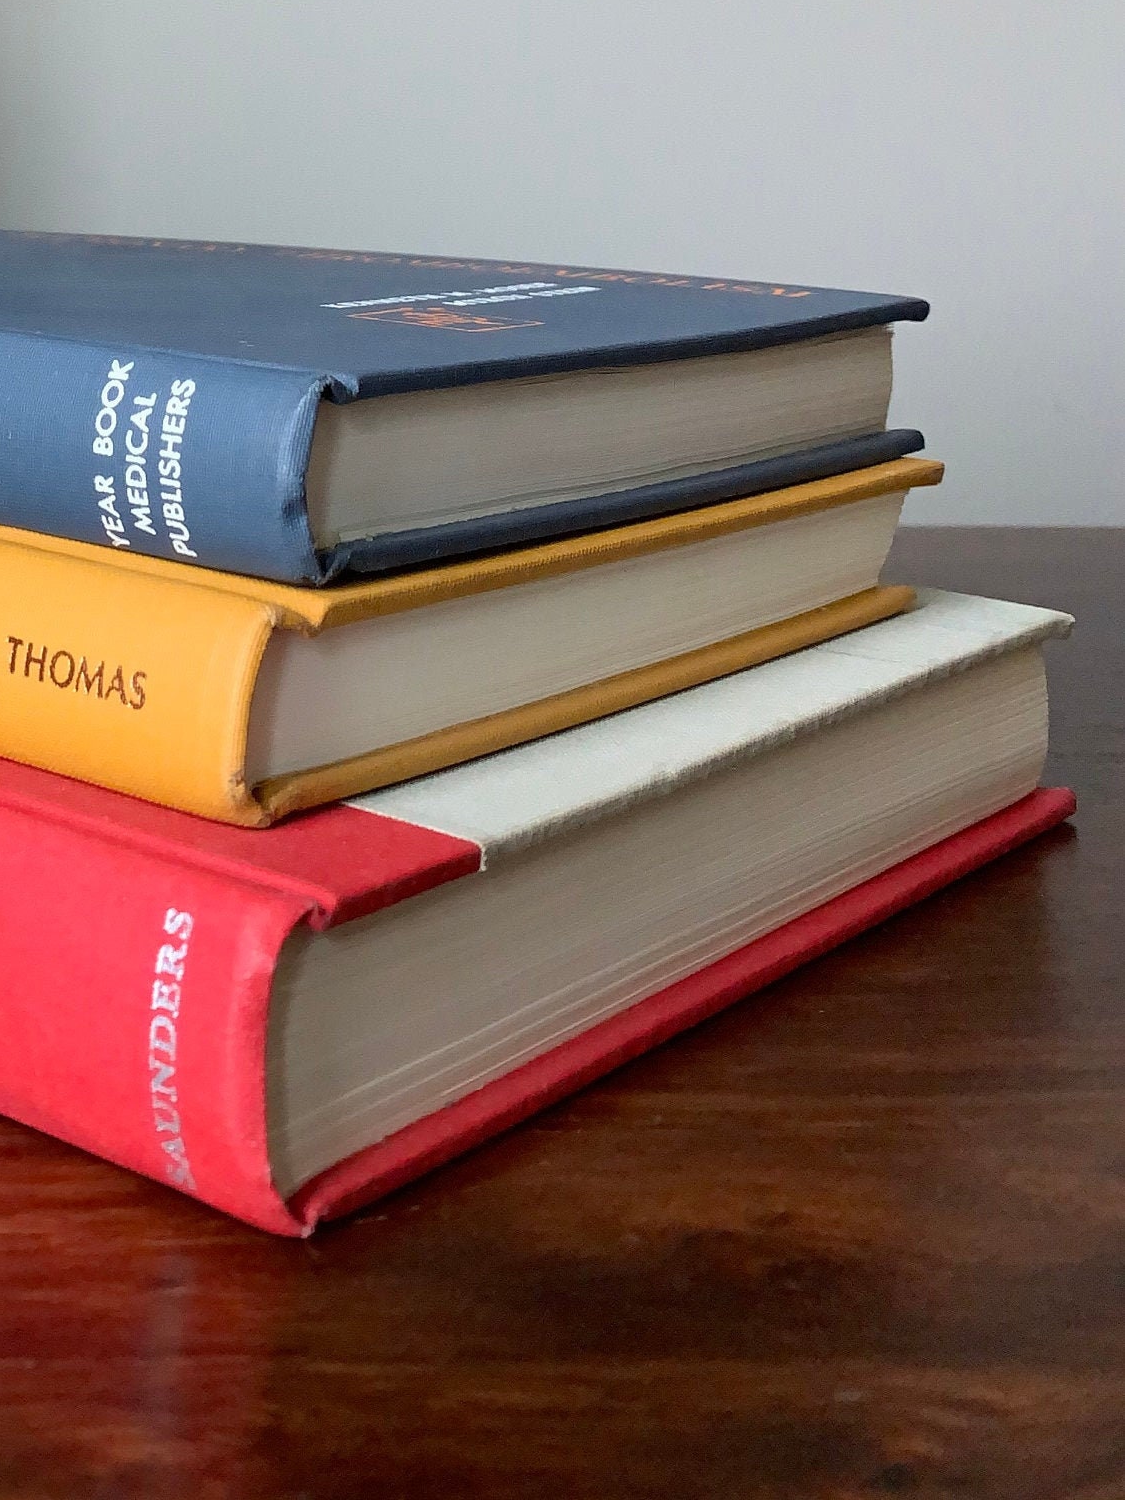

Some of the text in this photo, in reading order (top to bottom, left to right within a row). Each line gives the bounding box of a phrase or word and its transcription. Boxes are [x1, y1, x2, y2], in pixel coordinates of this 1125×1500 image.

[92, 359, 135, 547] YEAR BOOK
[125, 392, 157, 536] MEDICAL
[158, 378, 198, 558] PUBLISHERS
[7, 635, 148, 710] THOMAS
